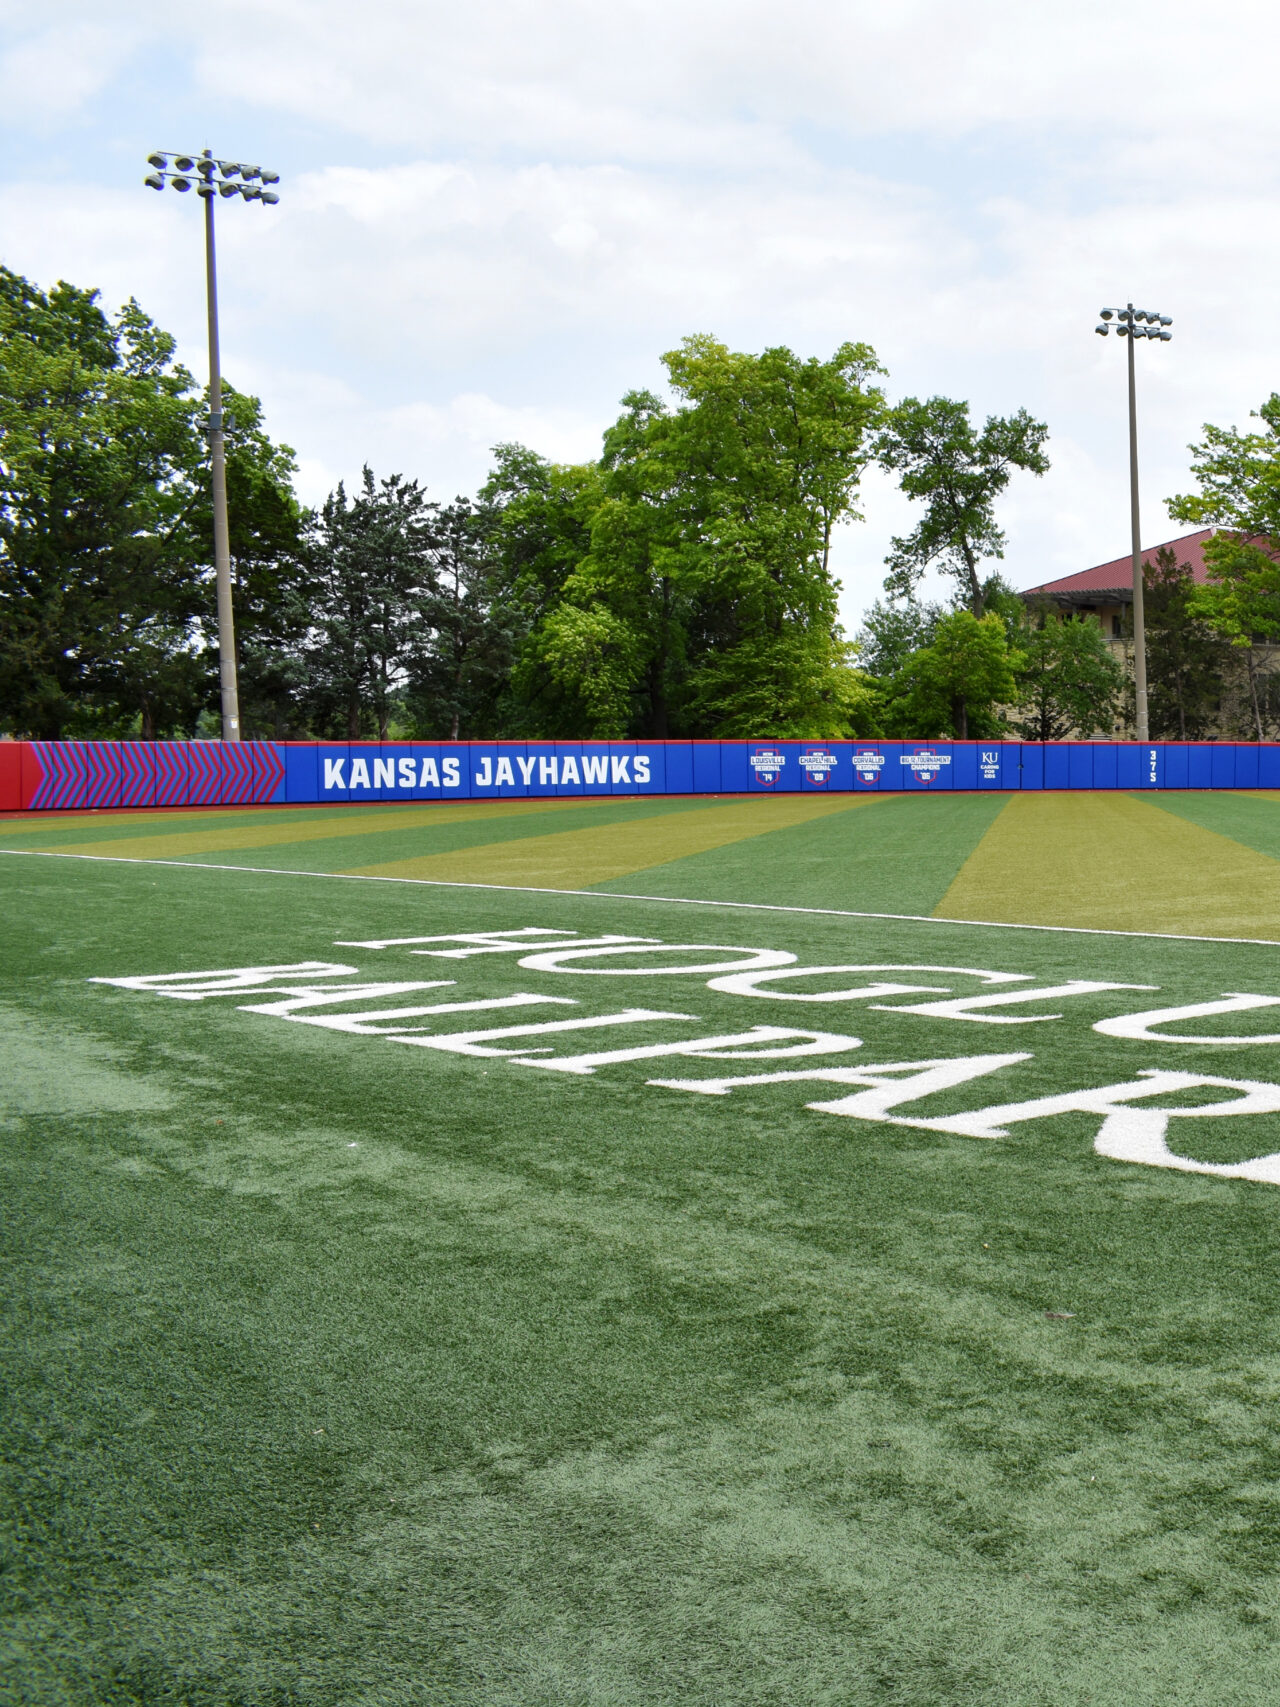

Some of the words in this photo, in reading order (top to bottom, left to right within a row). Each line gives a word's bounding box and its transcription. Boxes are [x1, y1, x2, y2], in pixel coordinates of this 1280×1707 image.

[751, 757, 785, 765] LOUISVILLE
[982, 752, 998, 764] KU
[324, 757, 460, 789] KANSAS
[476, 755, 651, 786] JAYHAWKS
